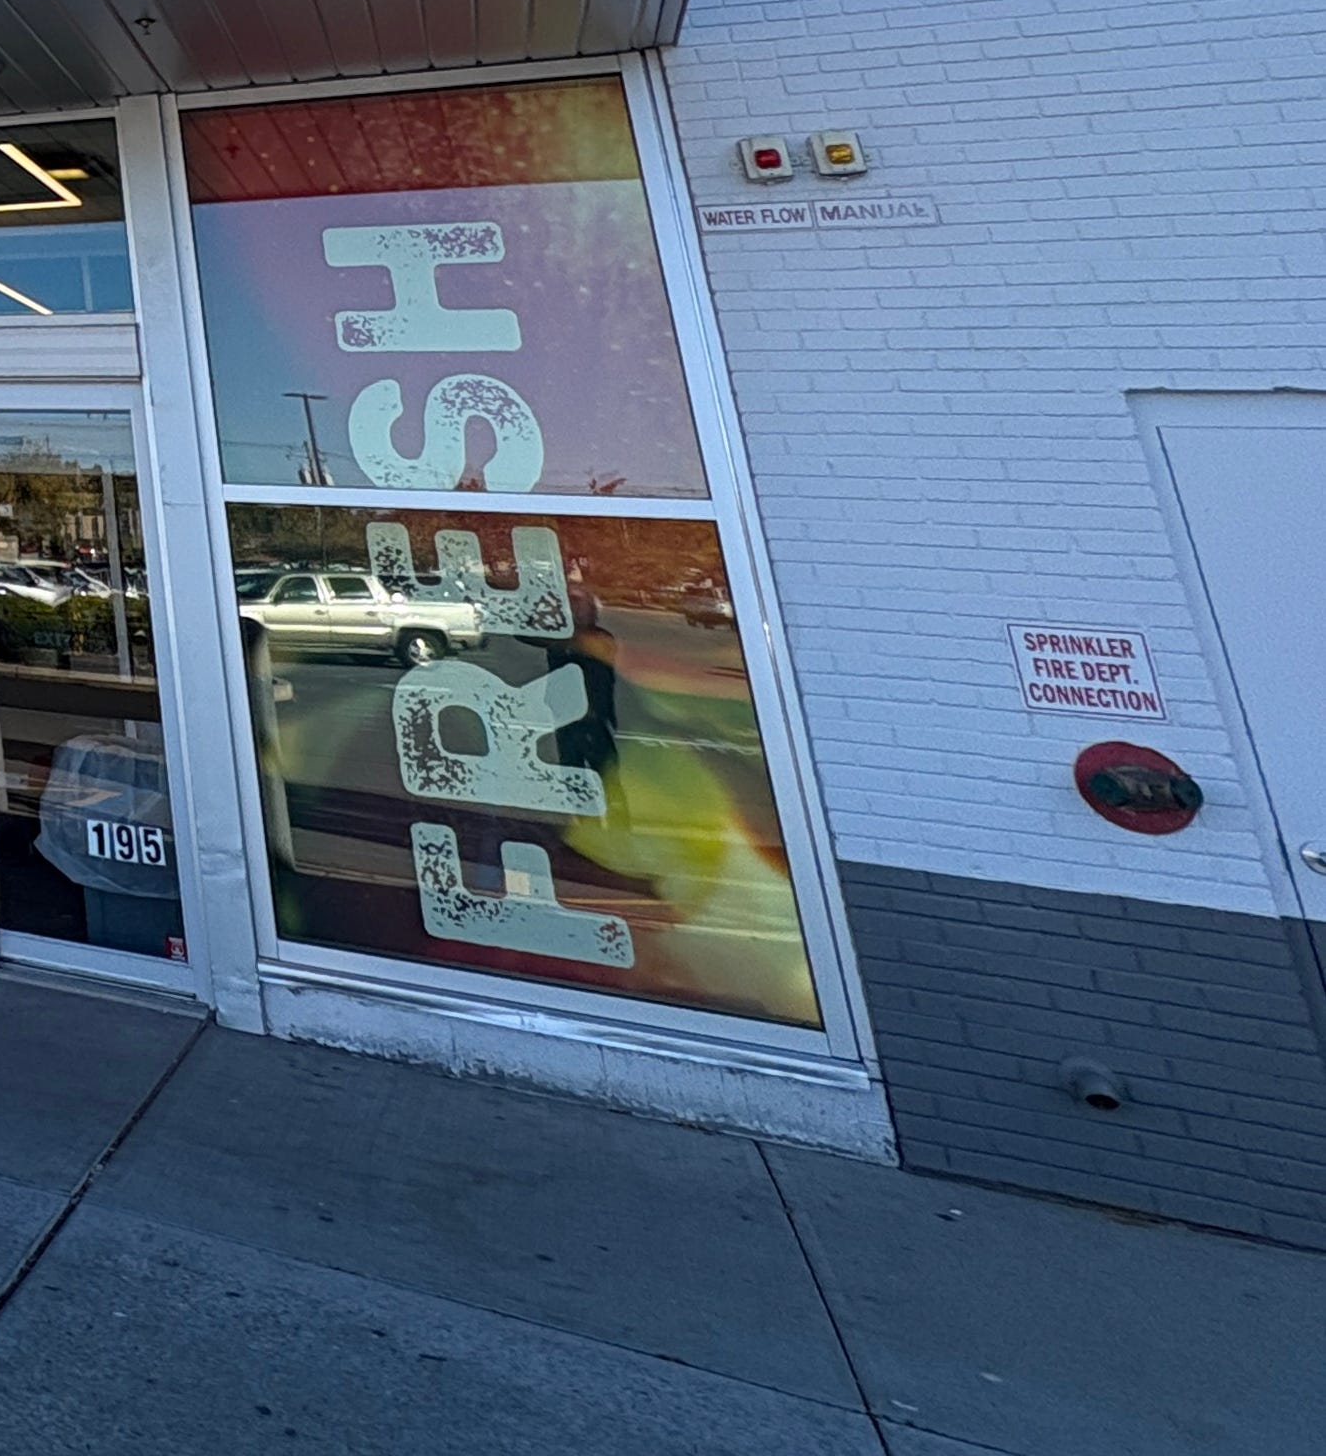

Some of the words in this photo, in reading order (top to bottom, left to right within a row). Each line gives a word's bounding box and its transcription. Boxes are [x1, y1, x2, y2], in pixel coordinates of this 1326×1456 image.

[702, 209, 756, 226] WATER
[761, 207, 806, 224] FLOW
[819, 202, 929, 221] MANUAL
[322, 221, 636, 969] FRESH
[1023, 632, 1136, 659] SPRINKLER
[1032, 657, 1080, 680] FIRE
[1080, 661, 1139, 685] DEPT.
[1028, 682, 1159, 712] CONNECTION
[92, 823, 162, 863] 195
